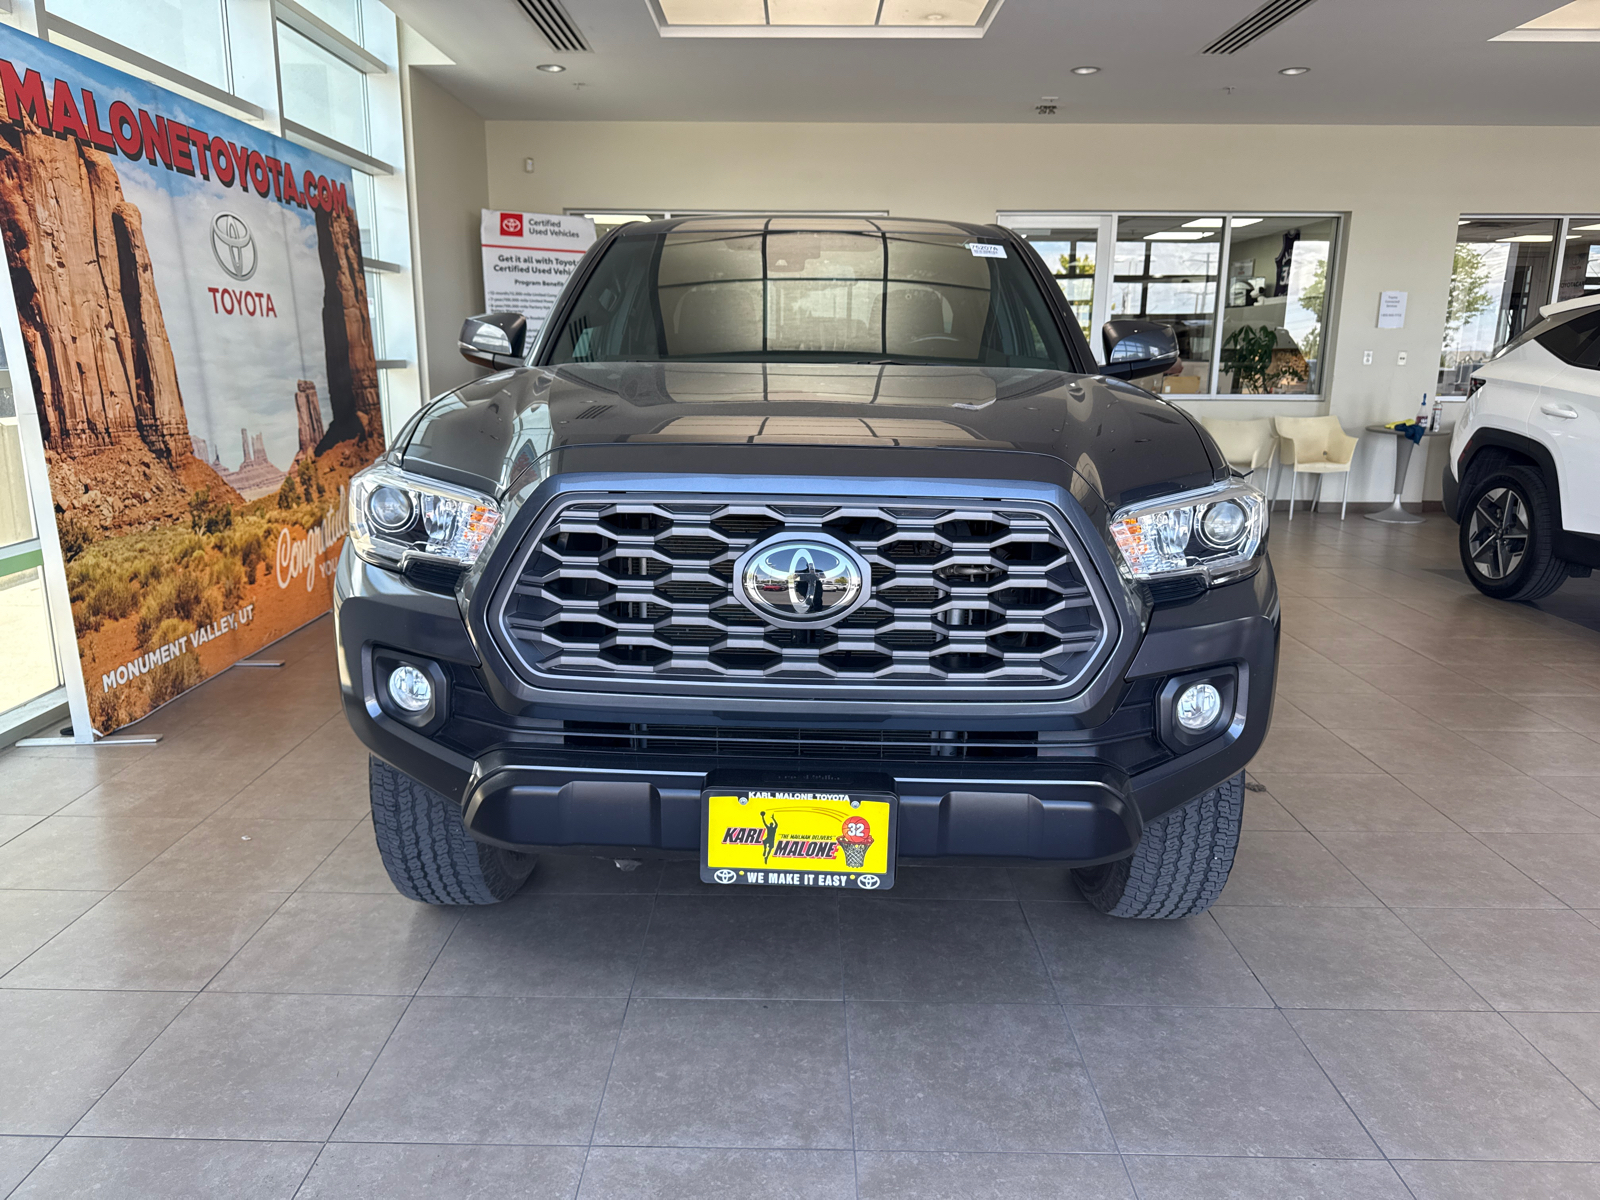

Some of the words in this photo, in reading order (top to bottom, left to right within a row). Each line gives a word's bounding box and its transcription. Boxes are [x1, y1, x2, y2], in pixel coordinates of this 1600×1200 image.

[528, 218, 561, 228] Certified
[528, 227, 548, 236] Used
[549, 229, 580, 238] Vehicles
[498, 255, 514, 263] Get
[515, 255, 522, 264] it
[523, 256, 534, 265] all
[535, 257, 553, 266] with
[555, 258, 579, 267] Toyot
[493, 264, 530, 274] Certified
[531, 266, 552, 275] Used
[553, 268, 571, 276] Vehi
[514, 279, 541, 287] Program
[208, 287, 278, 318] TOYOTA
[276, 485, 348, 592] Congratul
[319, 557, 338, 578] YOU
[102, 637, 187, 692] MONUMENT
[190, 612, 239, 649] VALLEY,
[238, 604, 255, 626] UT
[748, 791, 773, 799] KARL
[775, 792, 814, 801] MALONE
[815, 793, 850, 802] TOYOTA
[721, 827, 767, 845] KARL
[847, 823, 865, 837] 32
[773, 840, 838, 859] MALONE
[747, 872, 764, 883] WE
[768, 873, 800, 885] MAKE
[804, 874, 815, 885] IT
[818, 874, 847, 886] EASY
